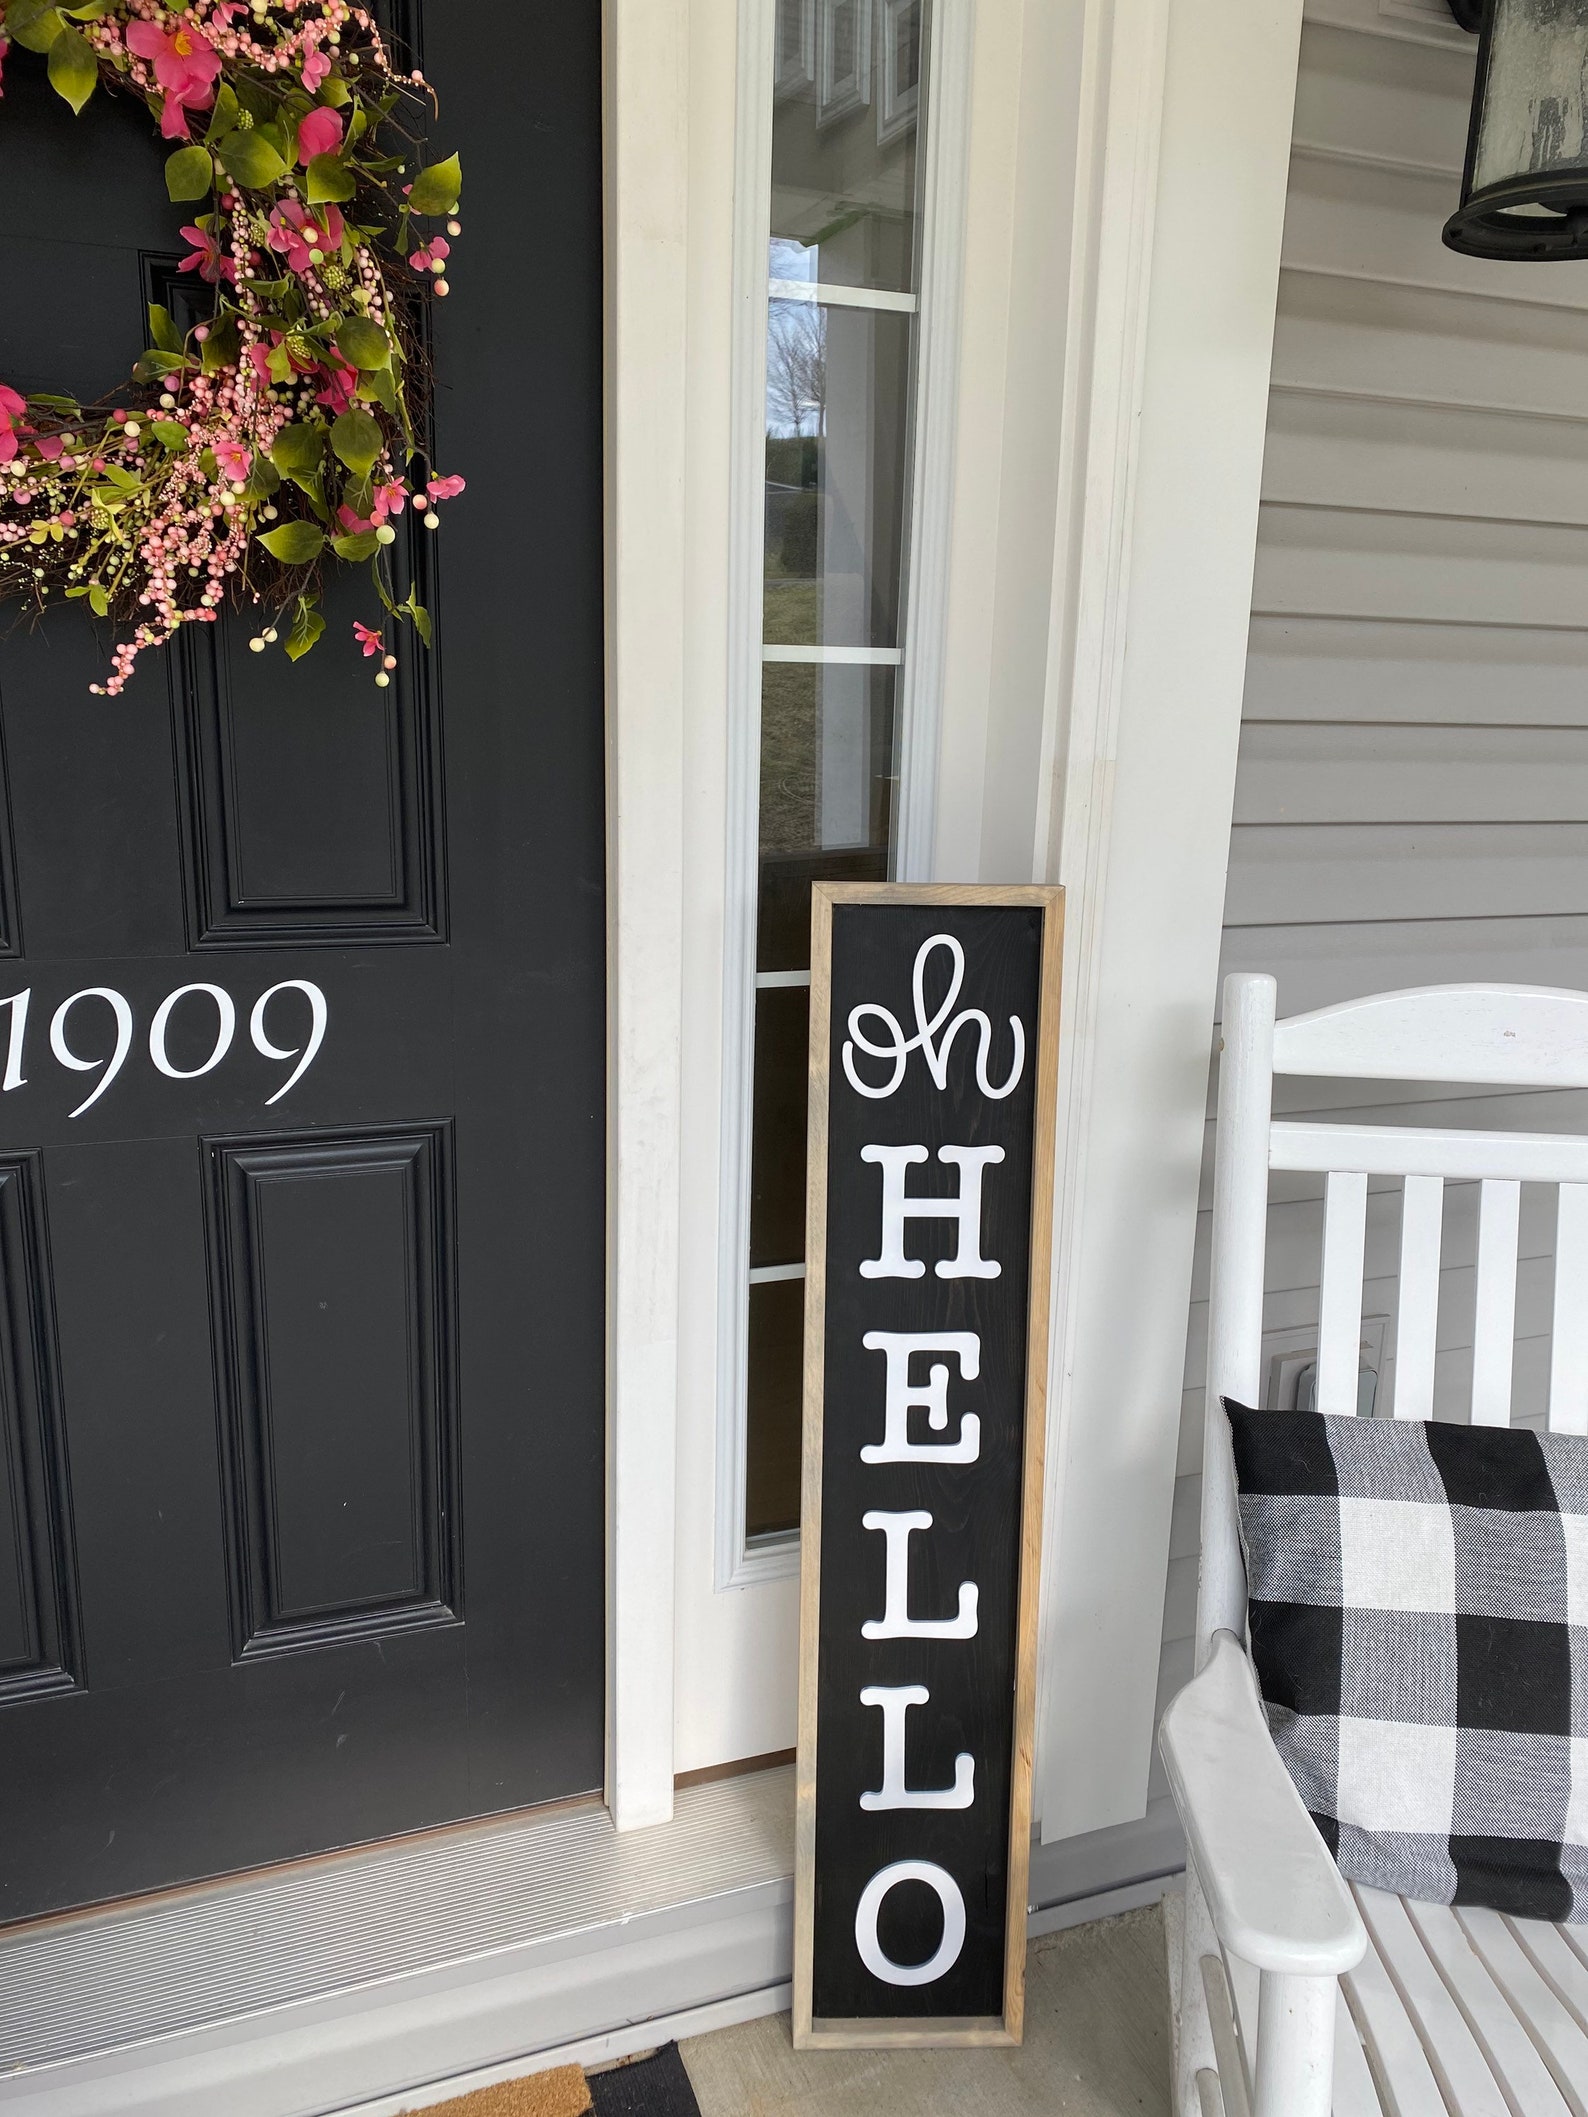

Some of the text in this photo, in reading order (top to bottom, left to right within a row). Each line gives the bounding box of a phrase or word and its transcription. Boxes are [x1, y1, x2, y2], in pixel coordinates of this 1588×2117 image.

[0, 979, 328, 1119] 1909
[841, 933, 1023, 1101] oh
[855, 1144, 1006, 1987] HELLO
